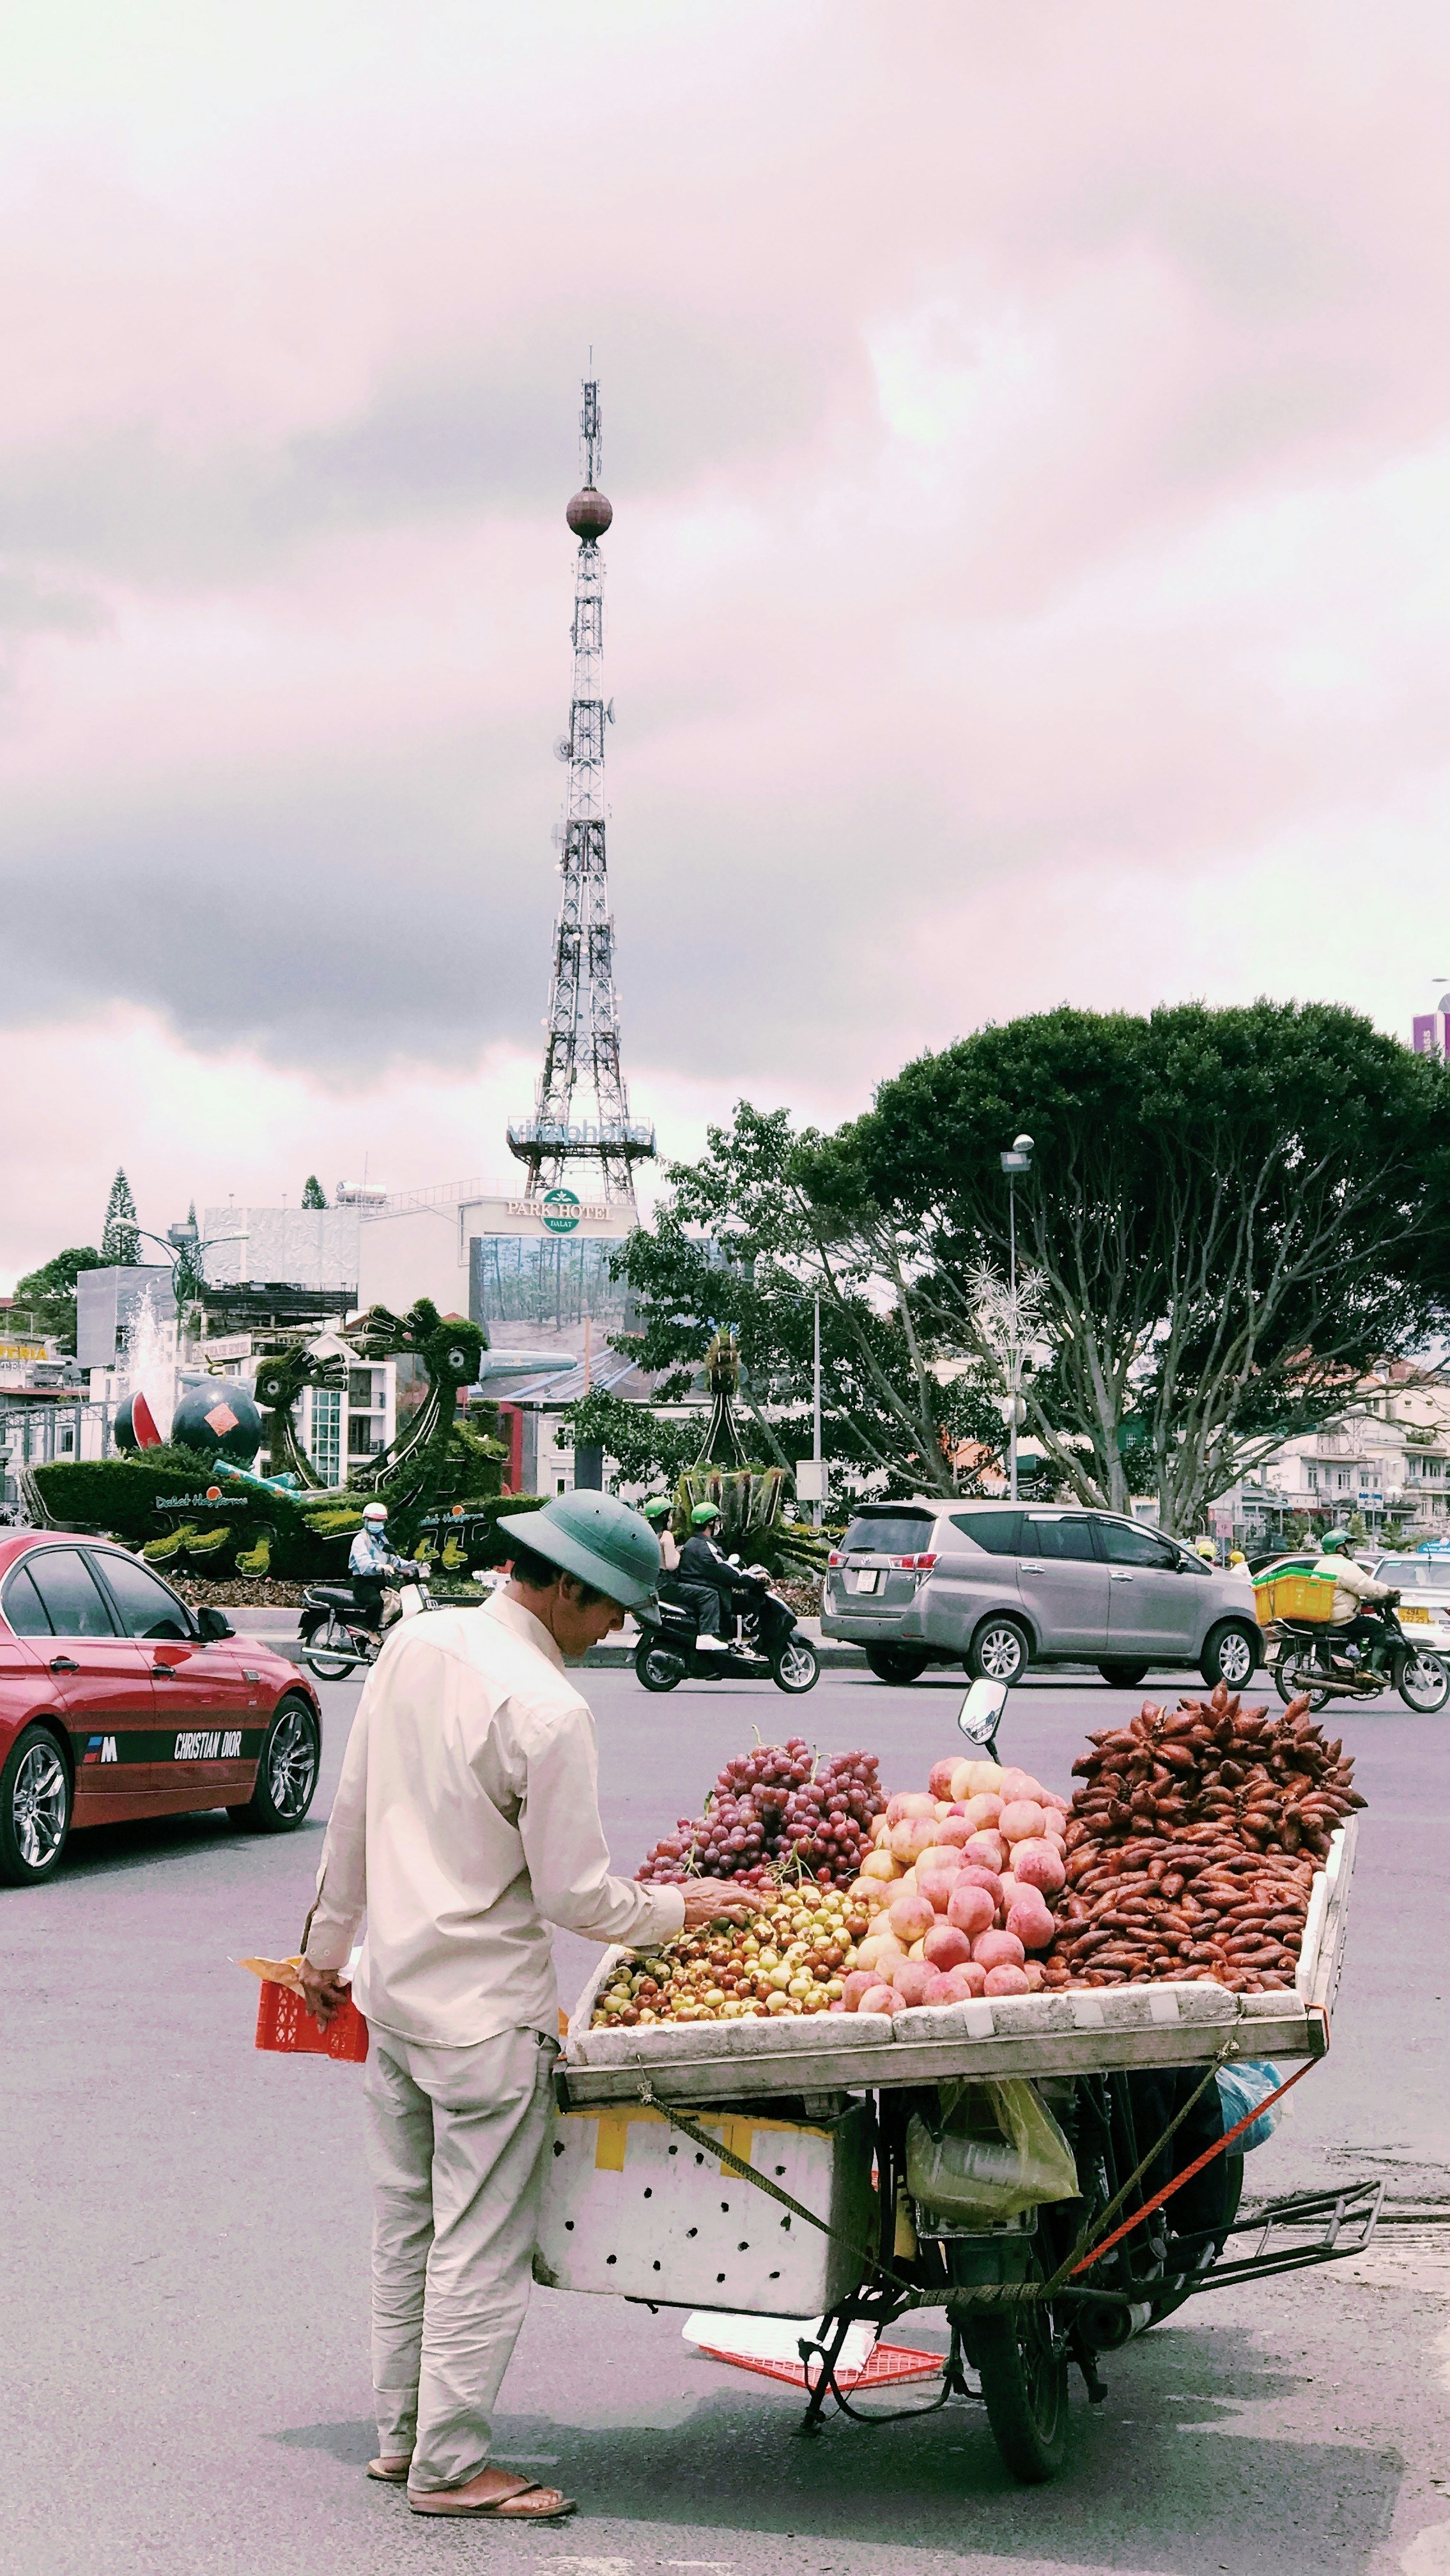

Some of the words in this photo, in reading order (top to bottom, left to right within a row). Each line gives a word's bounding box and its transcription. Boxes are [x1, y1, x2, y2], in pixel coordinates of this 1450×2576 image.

[508, 1119, 649, 1146] vinaphone
[507, 1201, 553, 1217] PARK
[557, 1203, 615, 1221] HOTEL
[156, 1493, 191, 1509] Dalat
[100, 1736, 118, 1762] M
[174, 1731, 221, 1760] CHRISTIAN
[220, 1731, 242, 1757] DIOR
